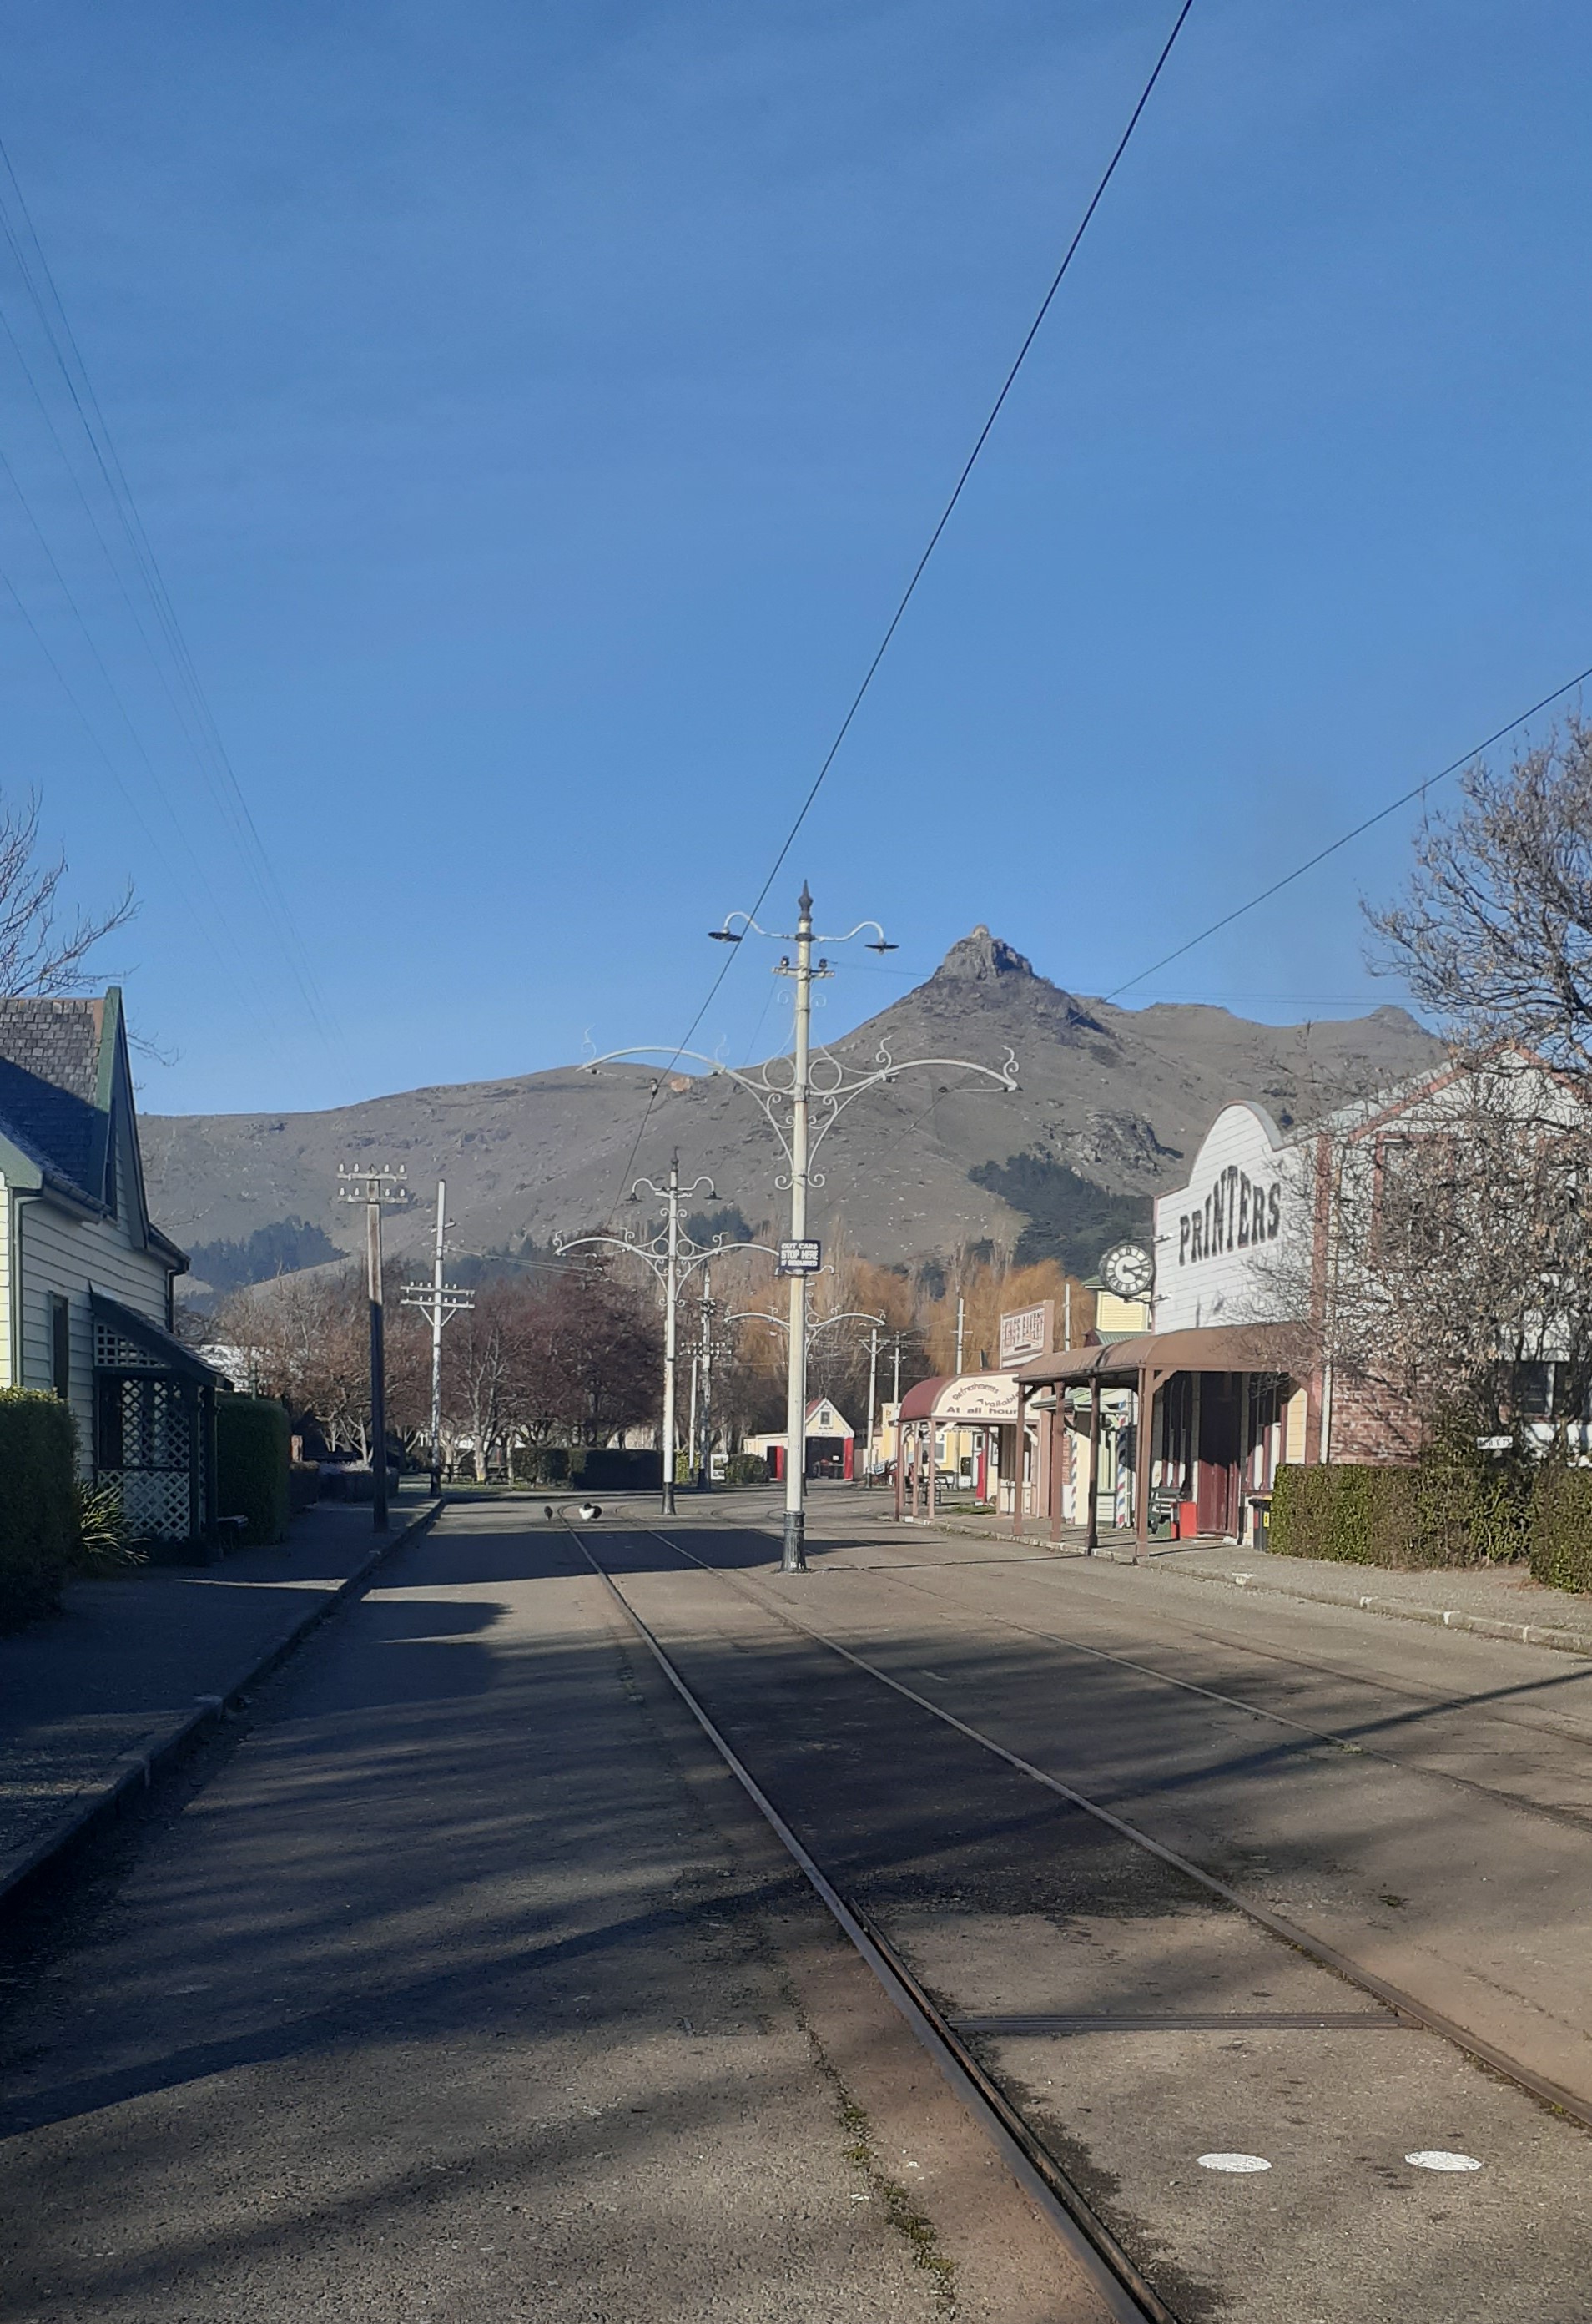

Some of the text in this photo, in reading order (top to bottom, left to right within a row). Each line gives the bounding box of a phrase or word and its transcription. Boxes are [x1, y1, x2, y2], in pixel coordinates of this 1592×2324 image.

[1178, 1165, 1281, 1267] PRINTERS
[781, 1250, 819, 1260] STOP HERE
[952, 1383, 999, 1400] Refreshments
